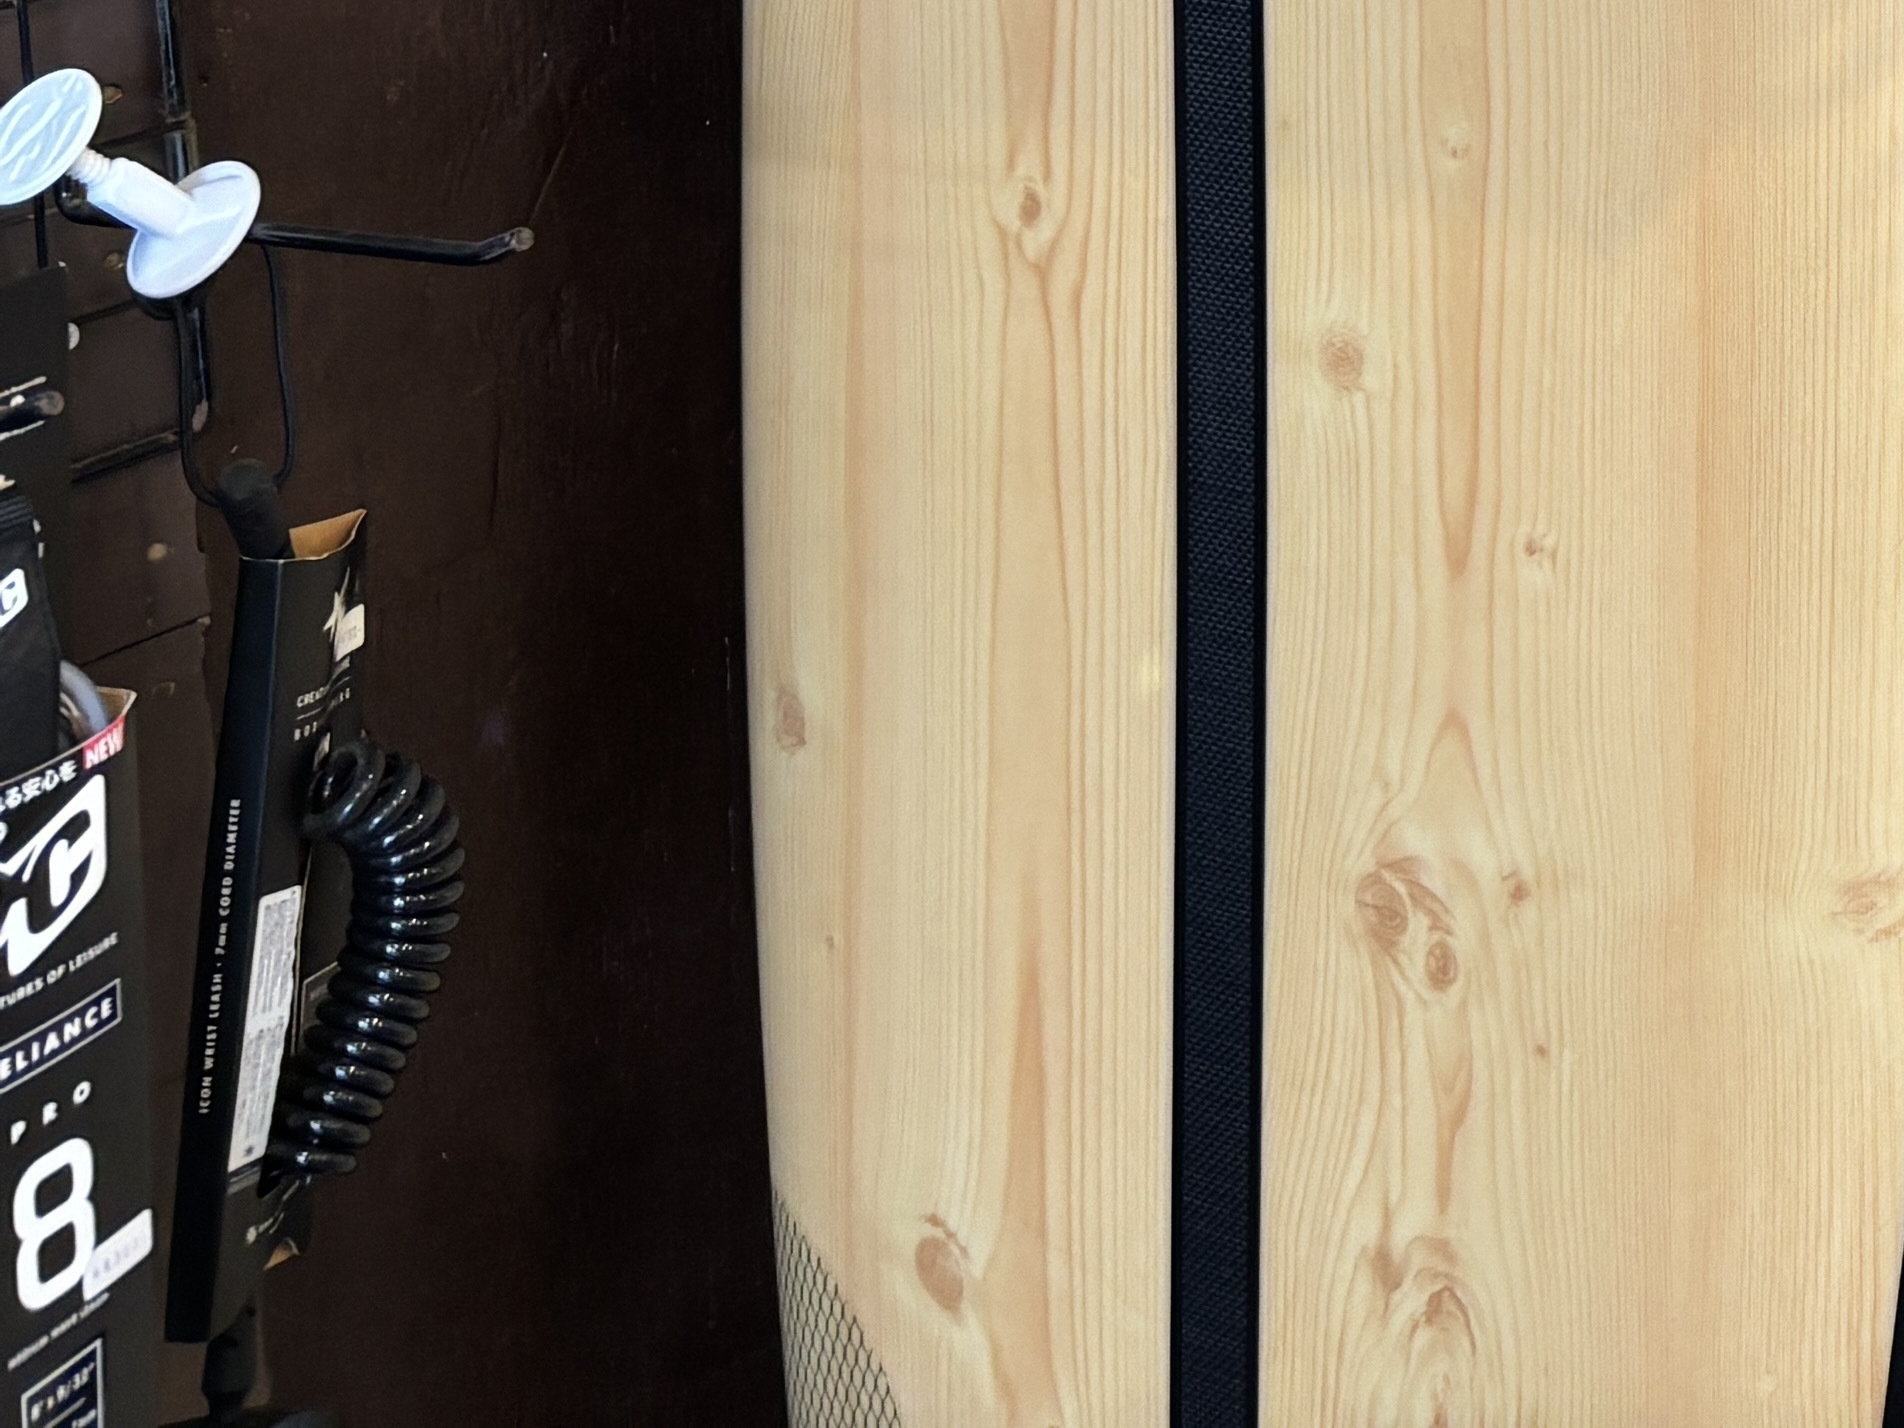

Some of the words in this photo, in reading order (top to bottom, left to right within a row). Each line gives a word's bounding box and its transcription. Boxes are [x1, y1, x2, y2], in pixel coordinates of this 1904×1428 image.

[84, 720, 124, 770] NEW
[223, 799, 241, 871] DIAMETER
[218, 876, 233, 917] CORD
[46, 964, 67, 985] OF
[68, 931, 119, 973] LEISURE
[208, 974, 224, 1018] LEASH
[204, 1026, 217, 1070] WRIST
[198, 1076, 213, 1114] ICON
[13, 1137, 96, 1312] 8
